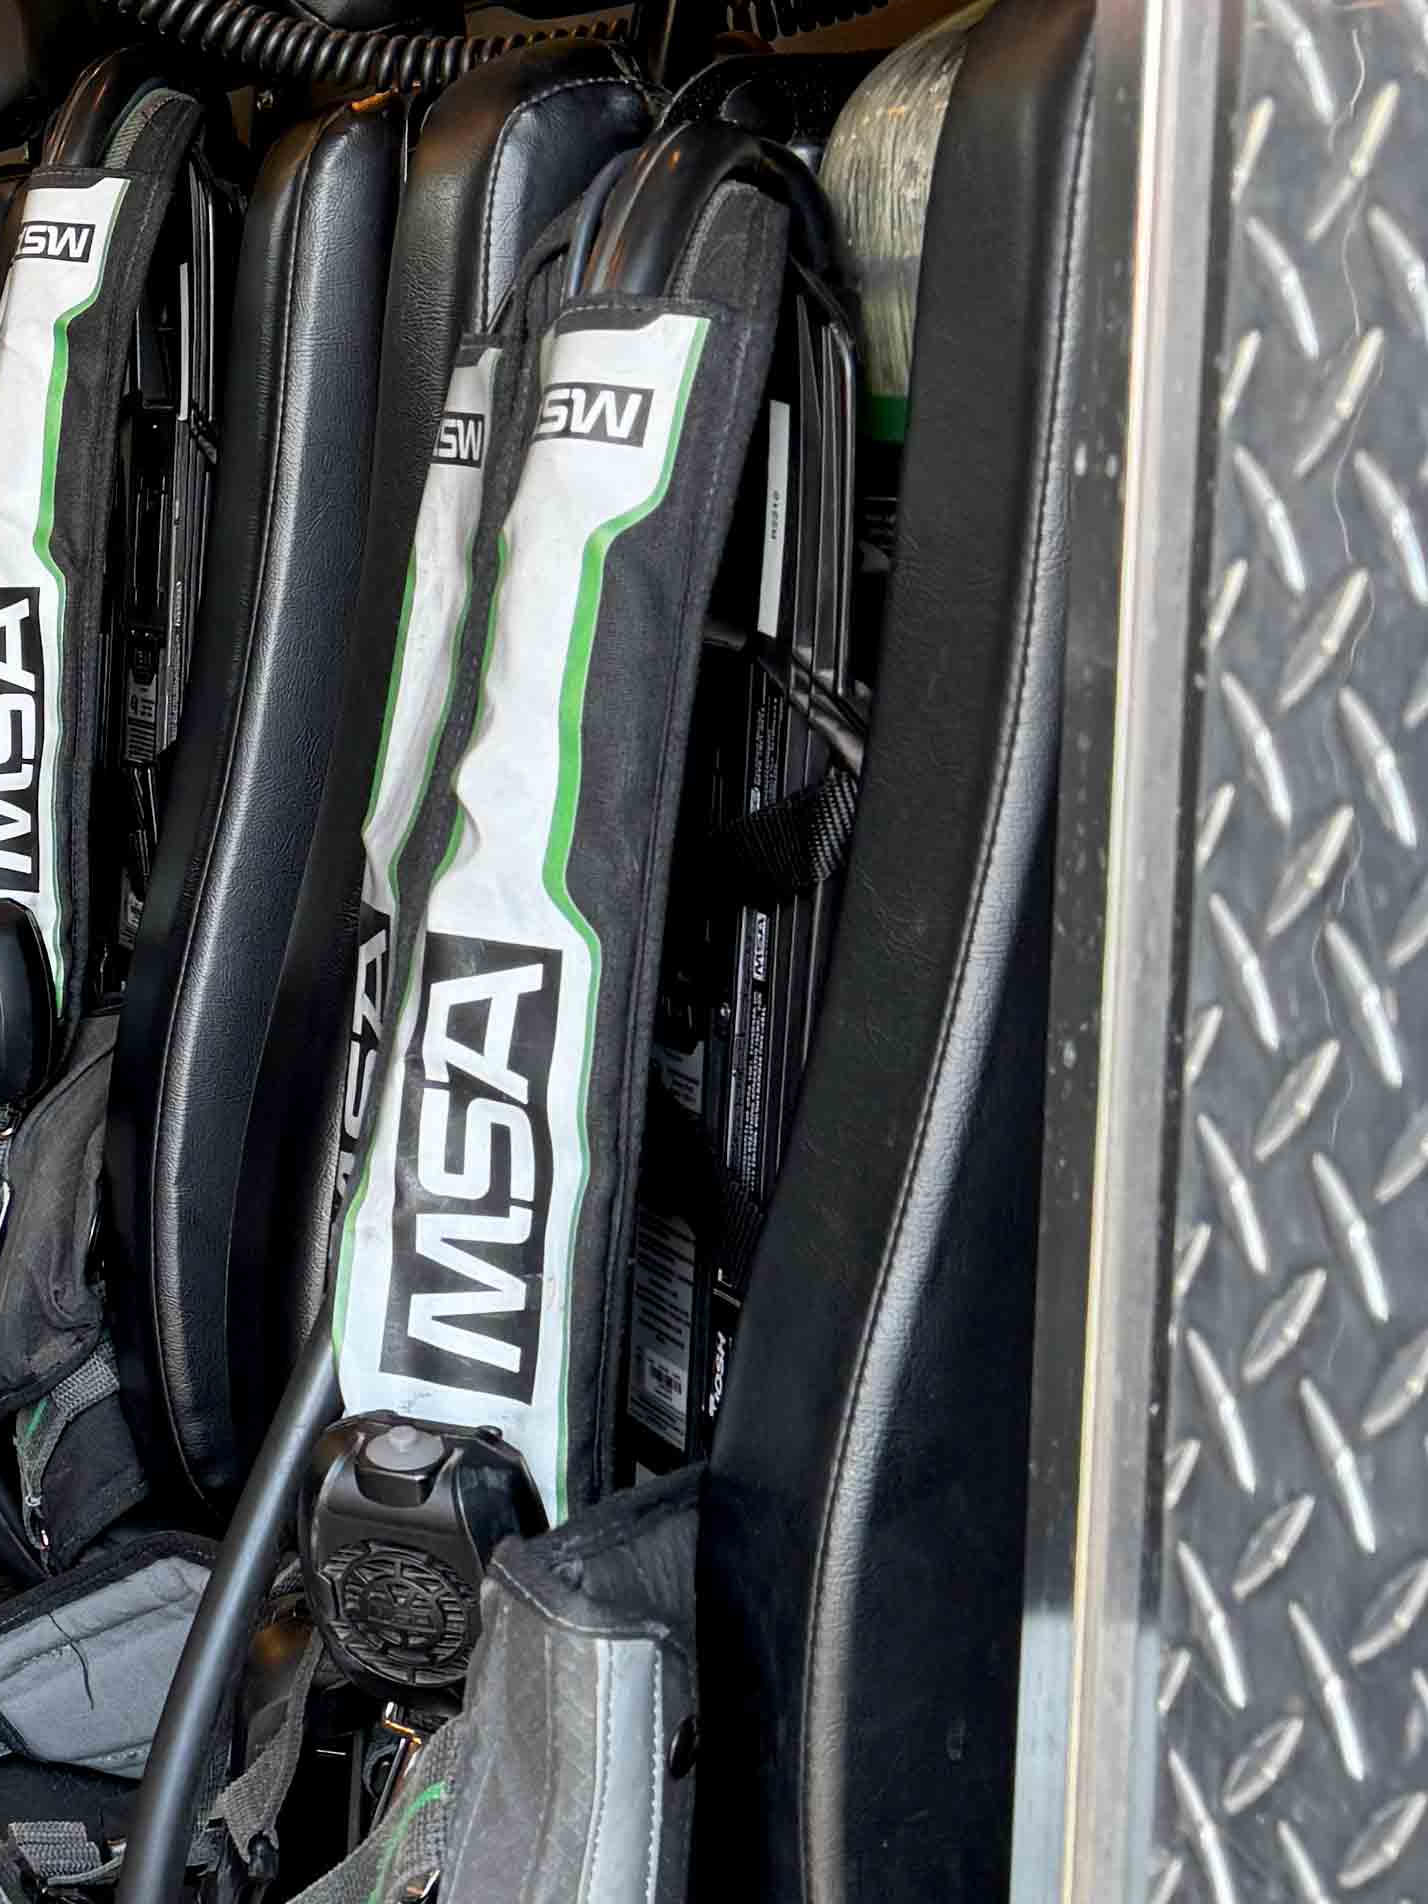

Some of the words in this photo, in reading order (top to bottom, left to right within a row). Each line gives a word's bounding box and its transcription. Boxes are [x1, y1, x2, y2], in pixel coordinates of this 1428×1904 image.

[15, 225, 90, 258] MS
[532, 387, 643, 439] MS
[433, 418, 483, 461] MS
[407, 963, 543, 1373] MSA
